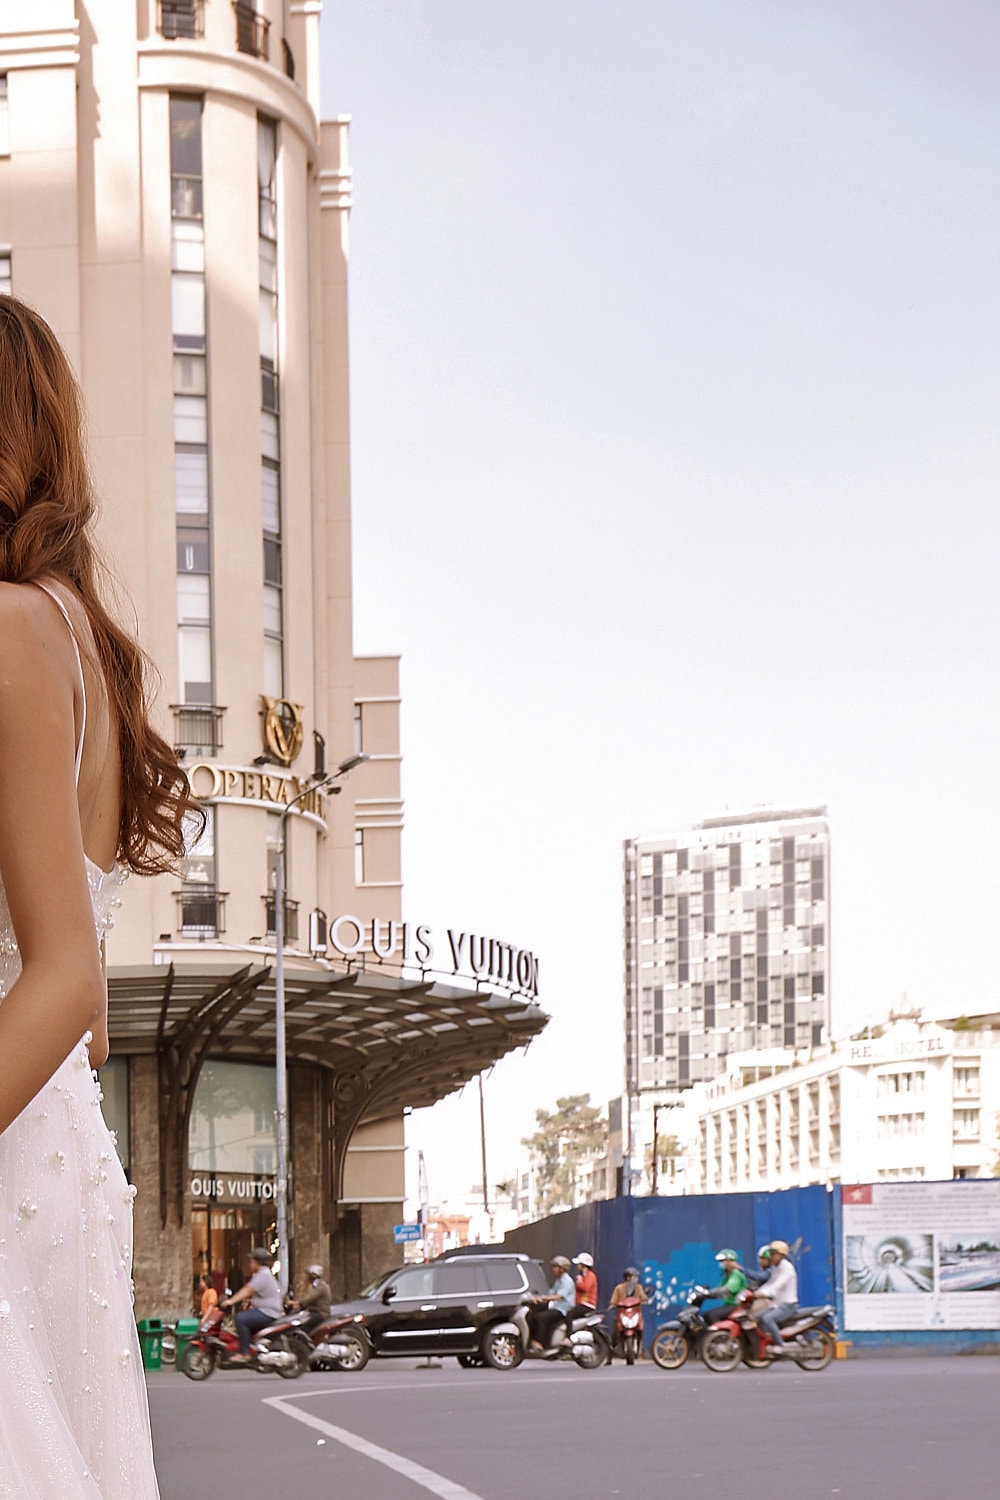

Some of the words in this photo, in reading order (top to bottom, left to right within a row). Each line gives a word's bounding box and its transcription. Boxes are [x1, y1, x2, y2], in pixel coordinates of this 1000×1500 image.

[188, 763, 291, 804] OPERA
[309, 912, 434, 964] LOUIS
[447, 929, 539, 996] VUITTON
